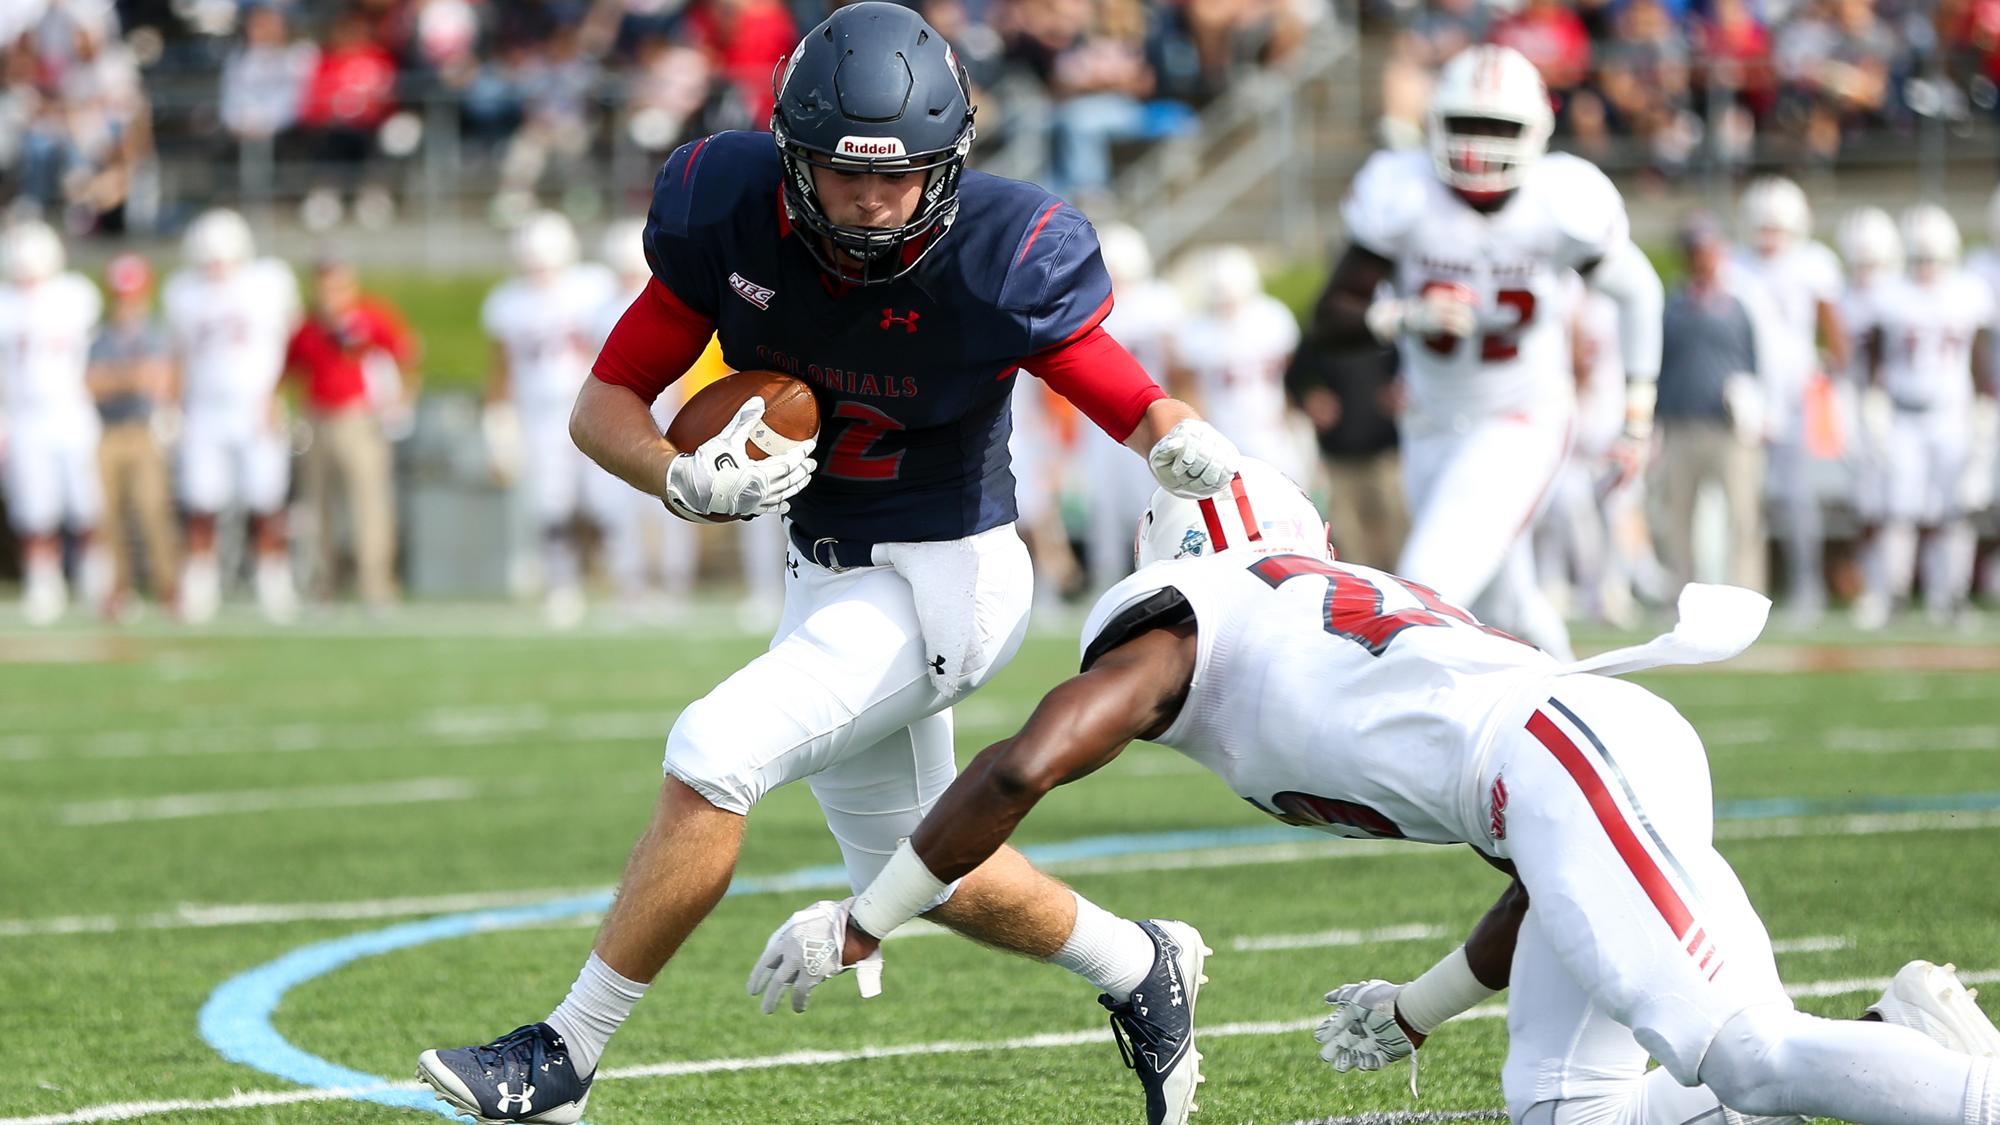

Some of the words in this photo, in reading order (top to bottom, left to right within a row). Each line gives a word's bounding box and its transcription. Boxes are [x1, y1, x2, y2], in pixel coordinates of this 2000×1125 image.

[844, 141, 897, 155] Riddell
[729, 272, 773, 303] NEC
[755, 344, 919, 398] COLONIALS
